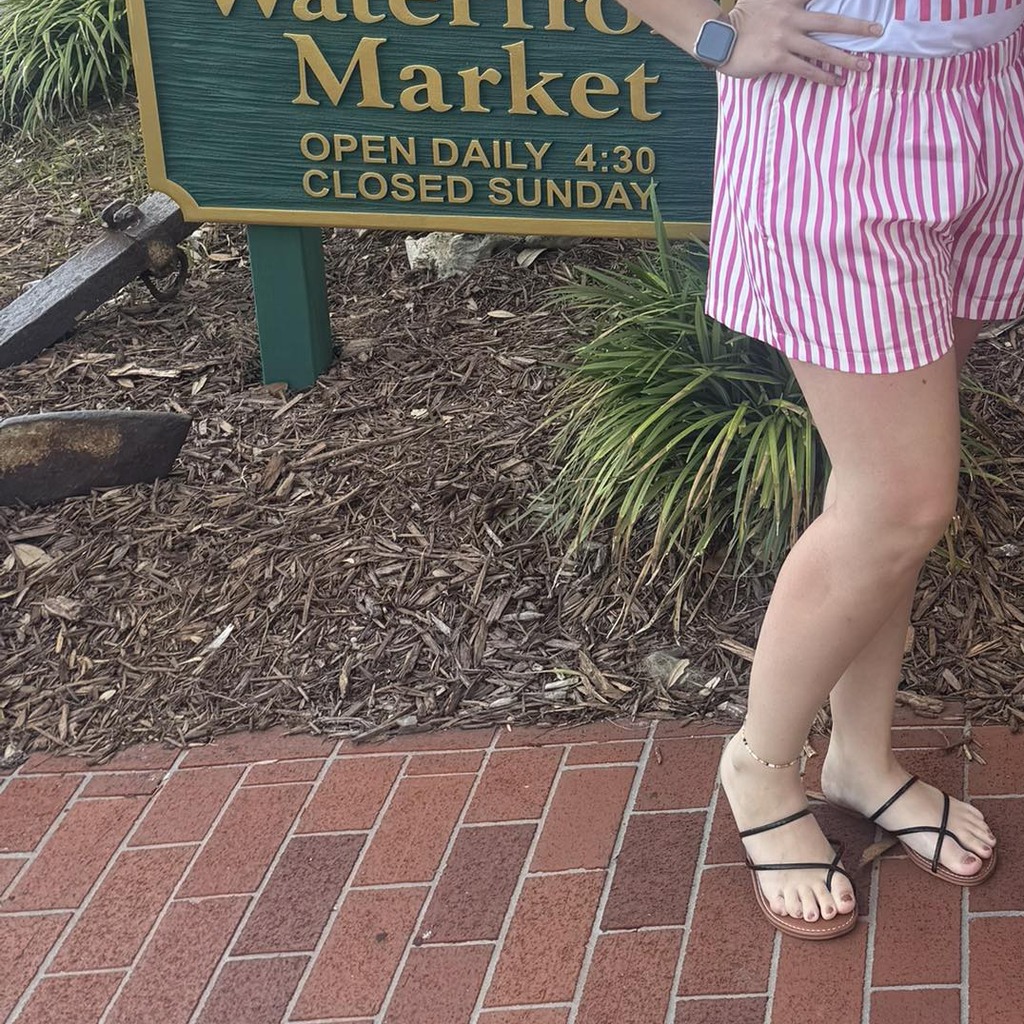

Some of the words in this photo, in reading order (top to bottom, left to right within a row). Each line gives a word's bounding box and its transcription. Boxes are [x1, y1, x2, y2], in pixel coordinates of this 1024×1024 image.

[283, 32, 663, 122] Market
[300, 132, 417, 166] OPEN
[432, 137, 552, 170] DAILY
[574, 144, 656, 175] 4:30
[302, 169, 474, 204] CLOSED
[488, 177, 659, 211] SUNDAY
